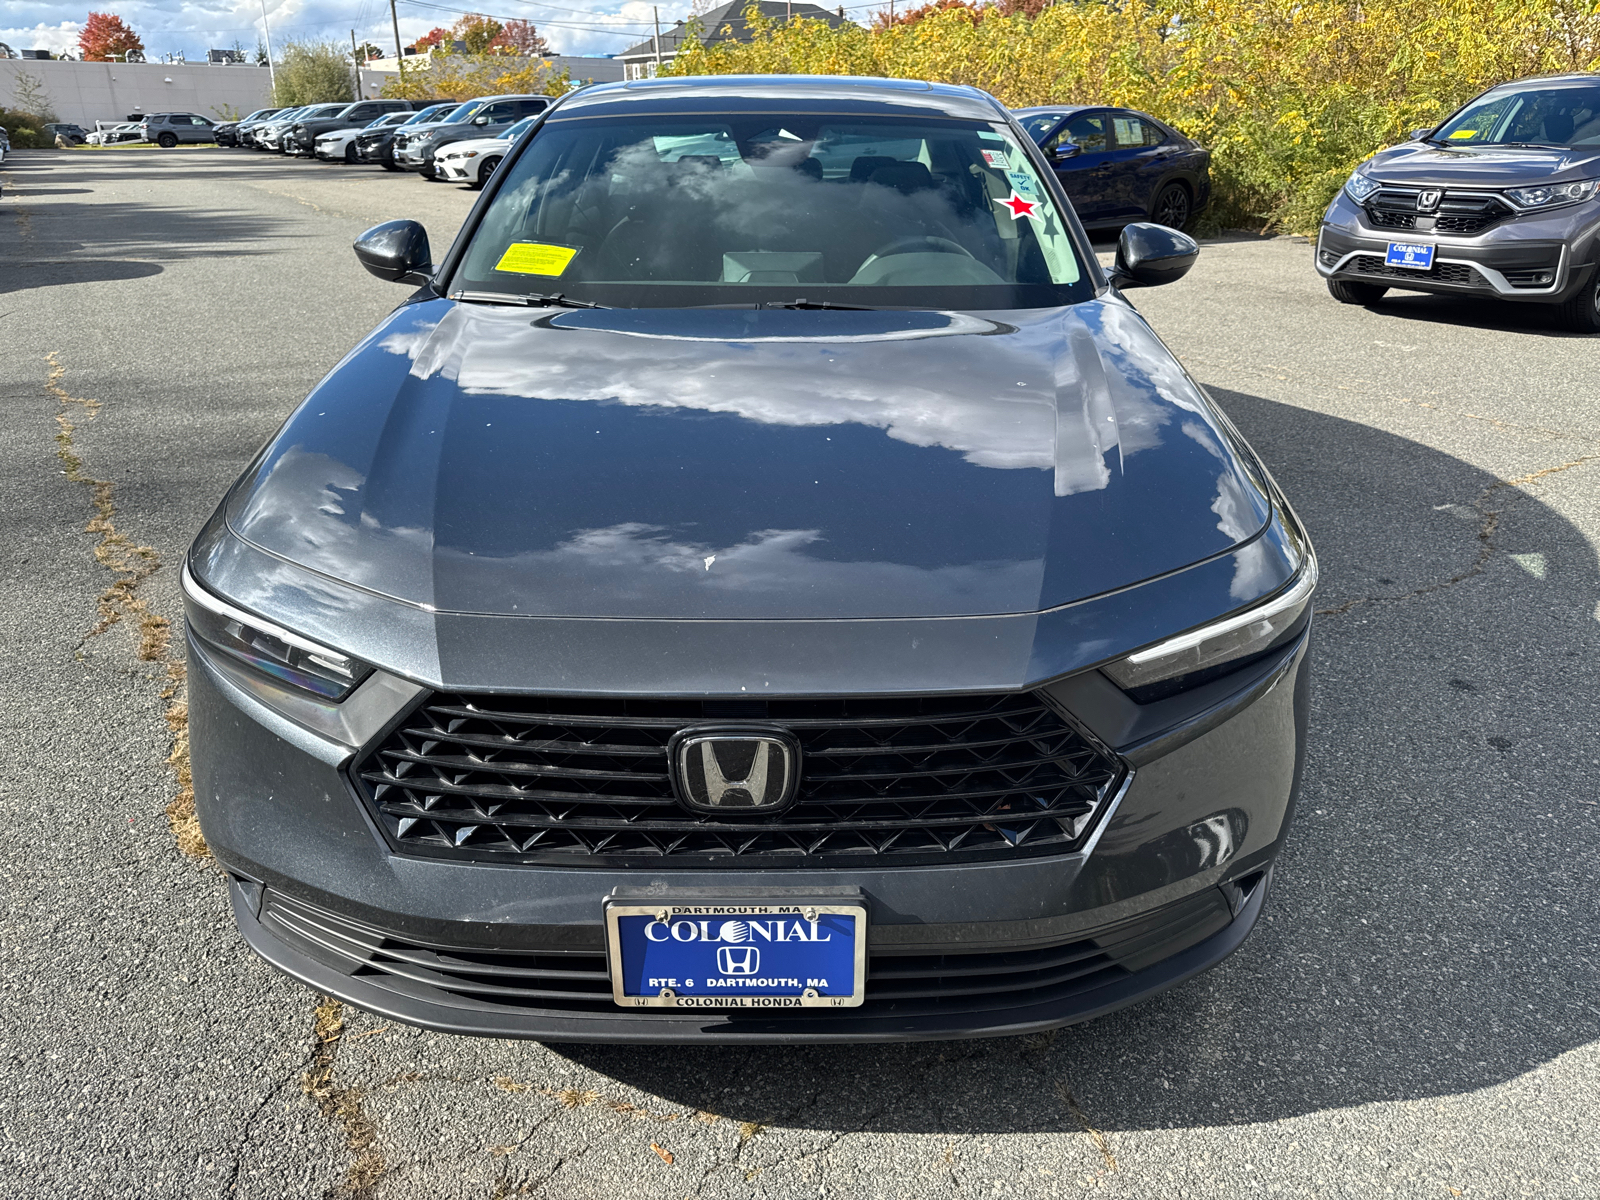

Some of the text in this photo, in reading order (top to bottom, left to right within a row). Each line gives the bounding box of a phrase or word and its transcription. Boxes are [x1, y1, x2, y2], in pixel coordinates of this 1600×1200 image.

[1393, 244, 1428, 254] COLONIAL
[644, 920, 831, 943] COLONIAL
[649, 978, 828, 989] RTE. 6 DARTMOUTH, MA
[676, 998, 802, 1007] COLONIAL HONDA
